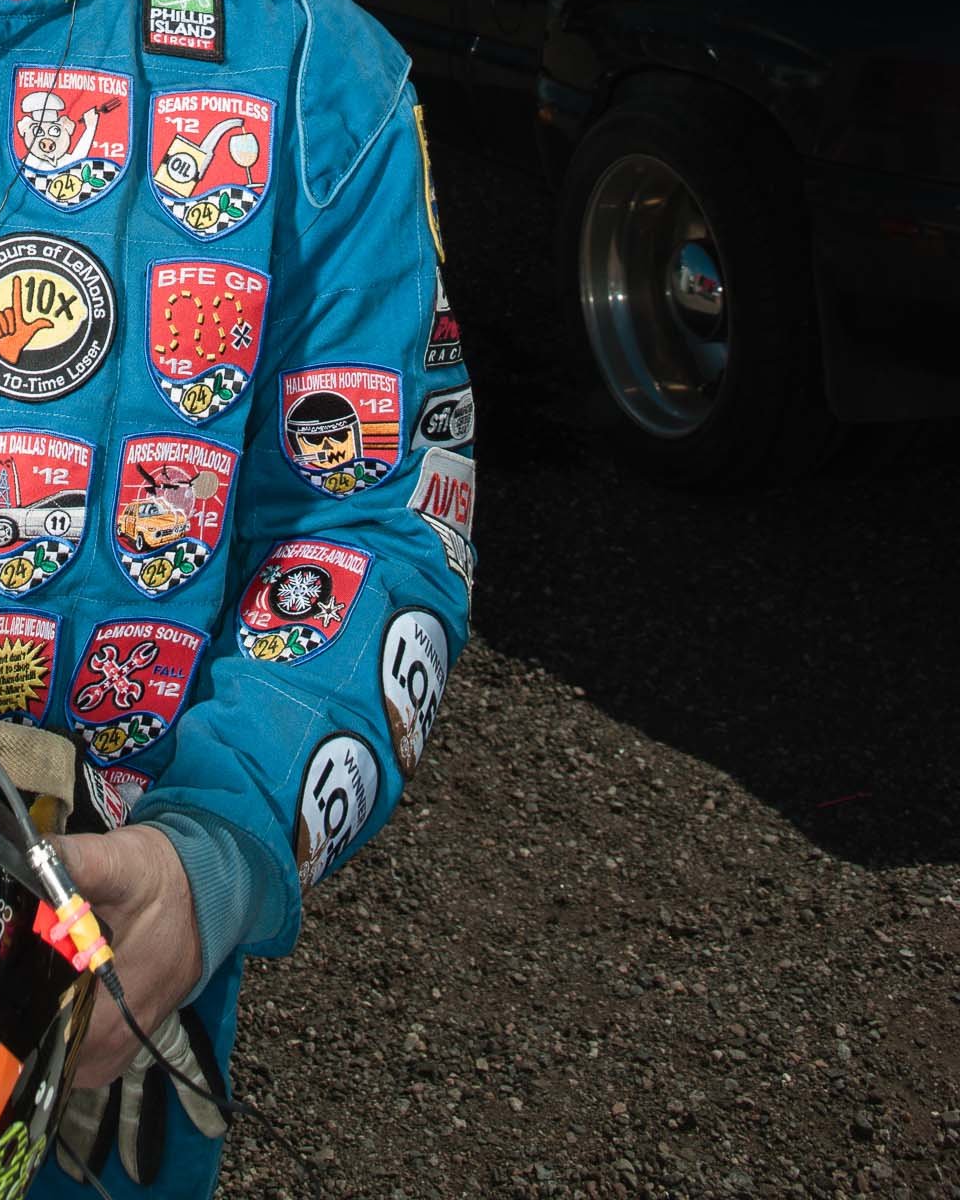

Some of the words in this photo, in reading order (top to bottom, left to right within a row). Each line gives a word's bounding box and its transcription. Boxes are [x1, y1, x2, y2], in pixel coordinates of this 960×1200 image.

[150, 8, 214, 25] PHILLIP
[150, 19, 216, 39] ISLAND
[153, 33, 210, 48] CIRCUIT
[18, 71, 56, 88] YEE-HAW
[58, 73, 96, 91] LEMONS
[98, 78, 127, 96] TEXAS
[158, 96, 198, 114] SEARS
[201, 96, 269, 122] POINTLESS
[164, 117, 199, 133] '12
[92, 143, 125, 158] '12
[170, 159, 191, 178] OIL
[53, 177, 75, 199] 24
[191, 205, 213, 227] 24
[42, 245, 64, 259] of
[63, 250, 105, 319] LeMons
[158, 268, 216, 287] BFE
[225, 272, 262, 293] GP
[2, 372, 65, 393] 10-Time
[67, 340, 101, 380] Loser
[160, 357, 193, 375] '12
[286, 373, 336, 395] HALLOWEEN
[339, 372, 396, 393] HOOPTIEFEST
[187, 386, 207, 412] 24
[359, 398, 394, 413] '12
[10, 435, 47, 456] DALLAS
[48, 439, 88, 467] HOOPTIE
[126, 442, 231, 476] ARSE-SWEAT-APALOOZA
[32, 466, 70, 485] '12
[329, 477, 350, 493] 24
[50, 516, 66, 531] 11
[272, 544, 370, 576] ARSE-FREEZE-APALOOZA
[4, 558, 27, 585] 24
[146, 559, 167, 585] 24
[9, 617, 24, 635] ARE
[23, 618, 36, 637] WE
[35, 620, 56, 640] DOING
[243, 609, 272, 627] '12
[96, 625, 154, 641] LeMONS
[155, 626, 200, 651] SOUTH
[258, 637, 279, 657] 24
[153, 665, 185, 679] FALL
[148, 680, 181, 698] '12
[99, 728, 120, 750] 24
[108, 771, 147, 786] IRONY
